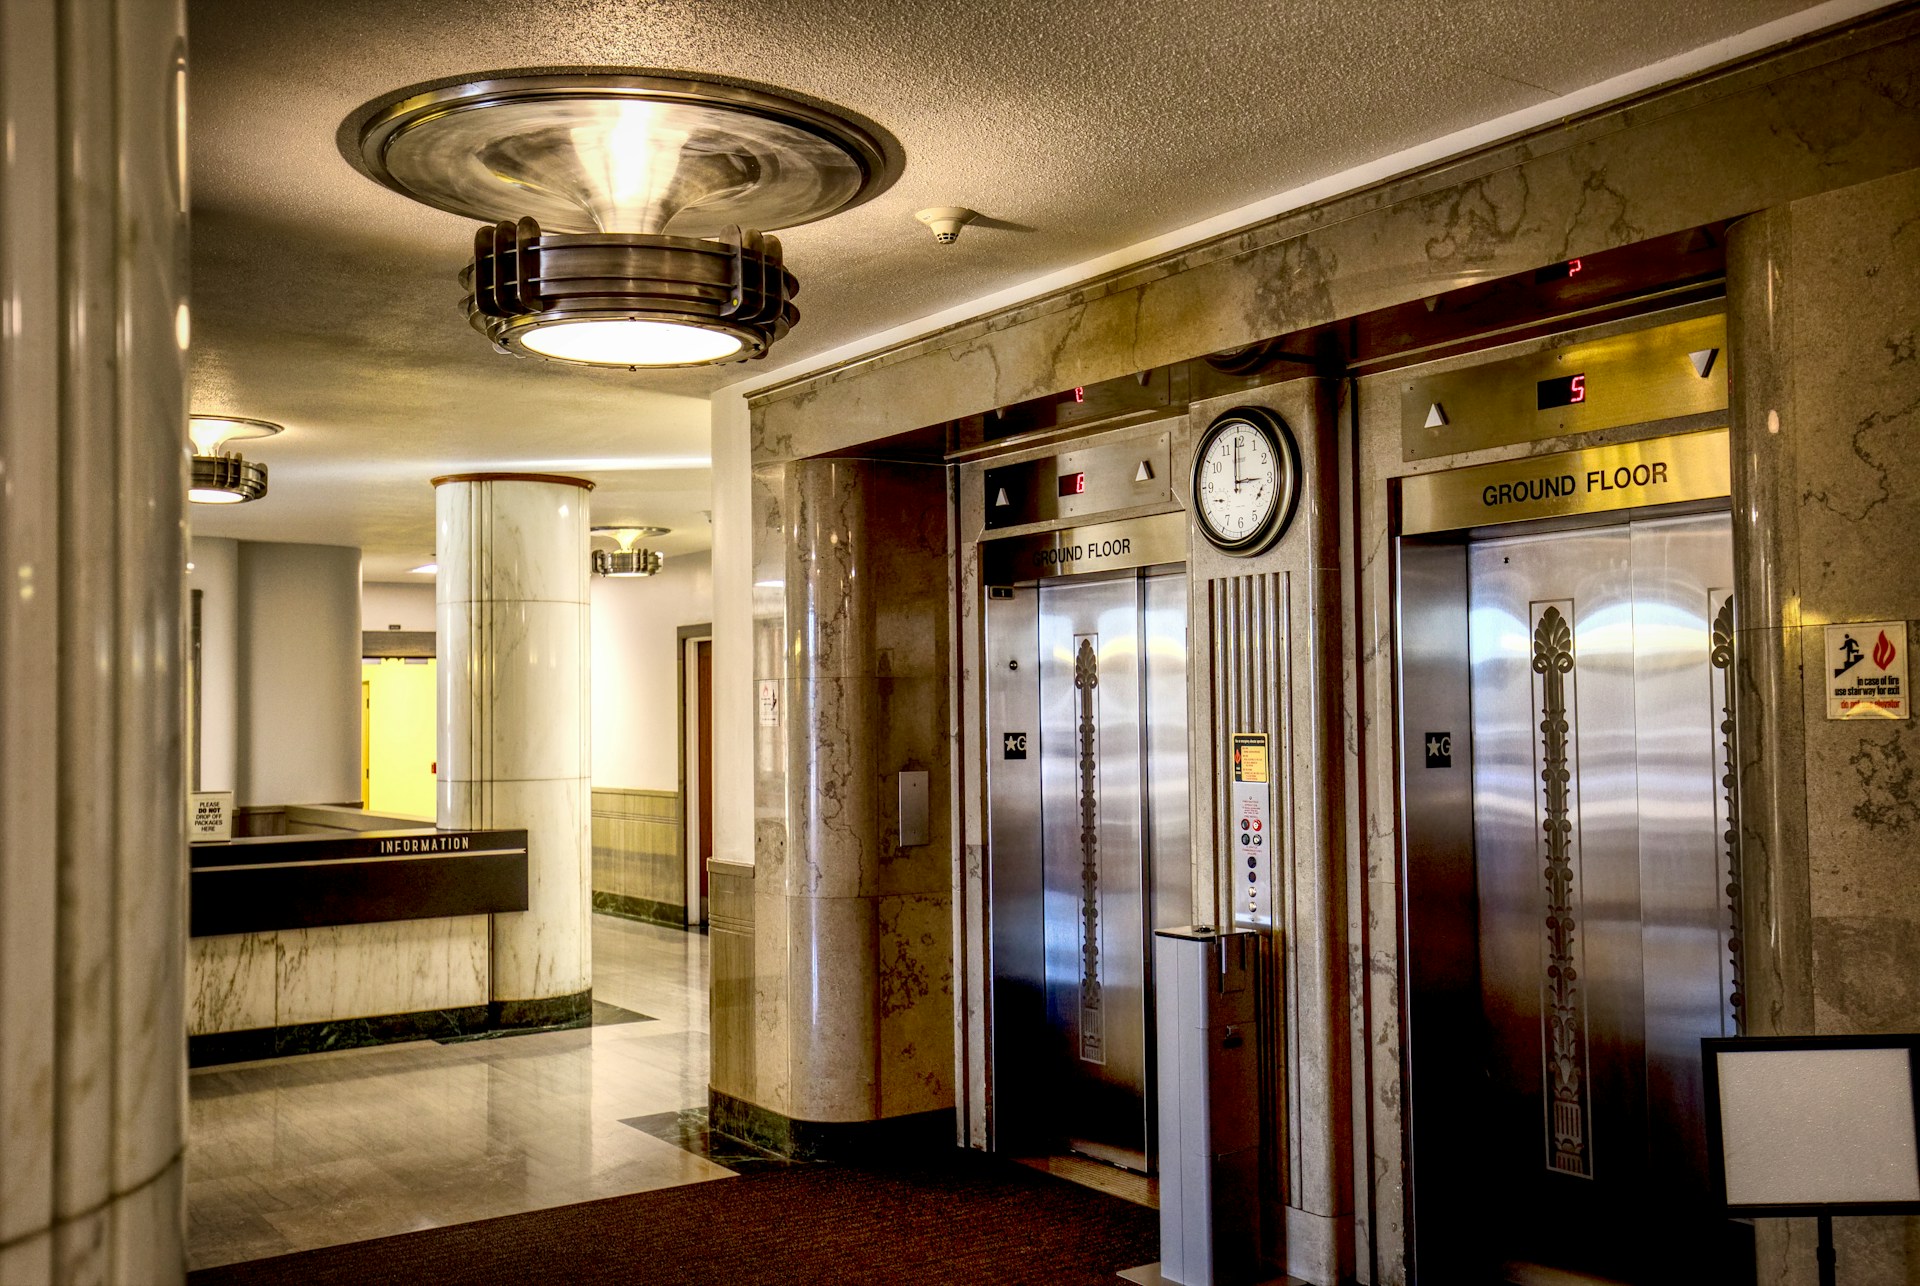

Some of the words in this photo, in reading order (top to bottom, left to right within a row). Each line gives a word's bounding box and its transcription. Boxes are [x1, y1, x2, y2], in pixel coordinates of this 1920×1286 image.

[1570, 375, 1585, 402] 5
[1221, 445, 1231, 456] 11
[1252, 440, 1257, 451] 1
[1261, 452, 1268, 464] 2
[1212, 461, 1222, 473] 10
[1266, 472, 1273, 483] 3
[1208, 482, 1214, 493] 9
[1482, 475, 1576, 507] GROUND
[1587, 462, 1668, 493] FLOOR
[1225, 514, 1231, 526] 7
[1251, 510, 1258, 521] 5
[1237, 517, 1244, 528] 6
[1033, 545, 1083, 567] GROUND
[1088, 538, 1131, 559] FLOOR
[1865, 677, 1879, 685] case
[1888, 675, 1899, 685] fire
[1835, 688, 1846, 696] use
[1847, 687, 1876, 697] stairway
[1877, 685, 1886, 695] for
[1887, 685, 1900, 695] exit
[1016, 735, 1026, 751] G
[1441, 736, 1451, 756] G
[380, 837, 469, 853] INFORMATION
